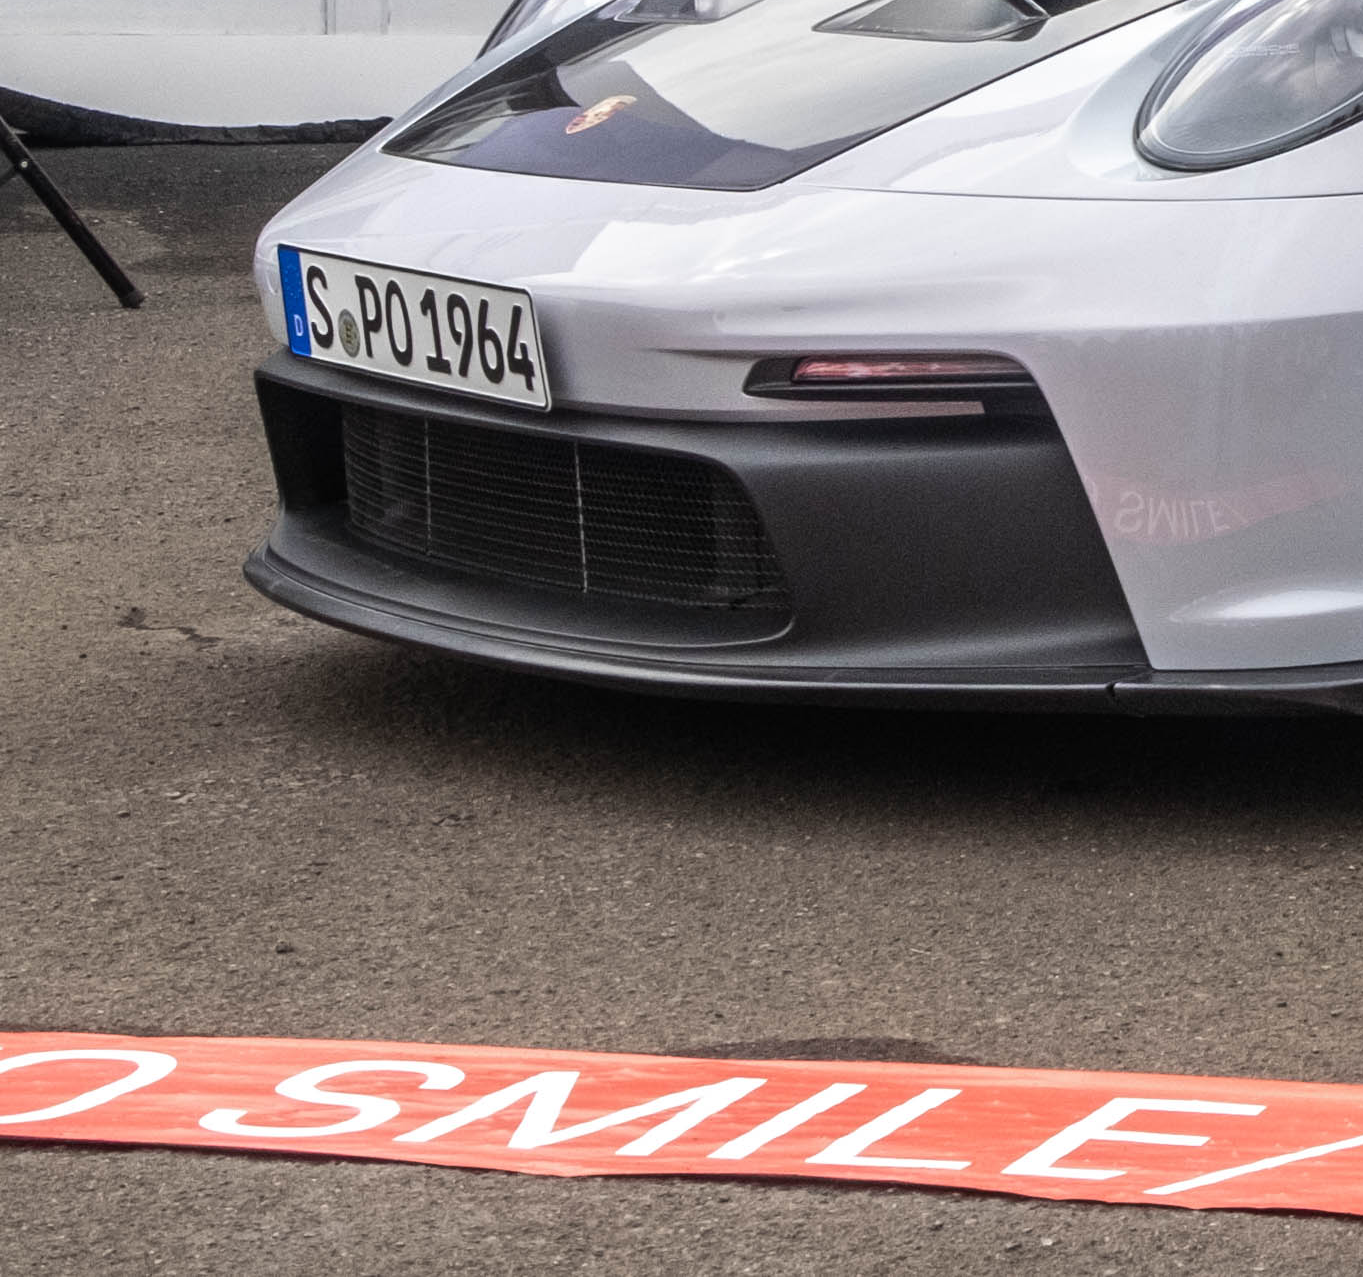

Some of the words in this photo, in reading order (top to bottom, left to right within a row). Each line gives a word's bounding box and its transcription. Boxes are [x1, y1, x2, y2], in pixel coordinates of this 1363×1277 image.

[294, 313, 304, 337] D
[306, 264, 335, 349] S
[354, 274, 413, 366] PO
[420, 288, 536, 391] 1964
